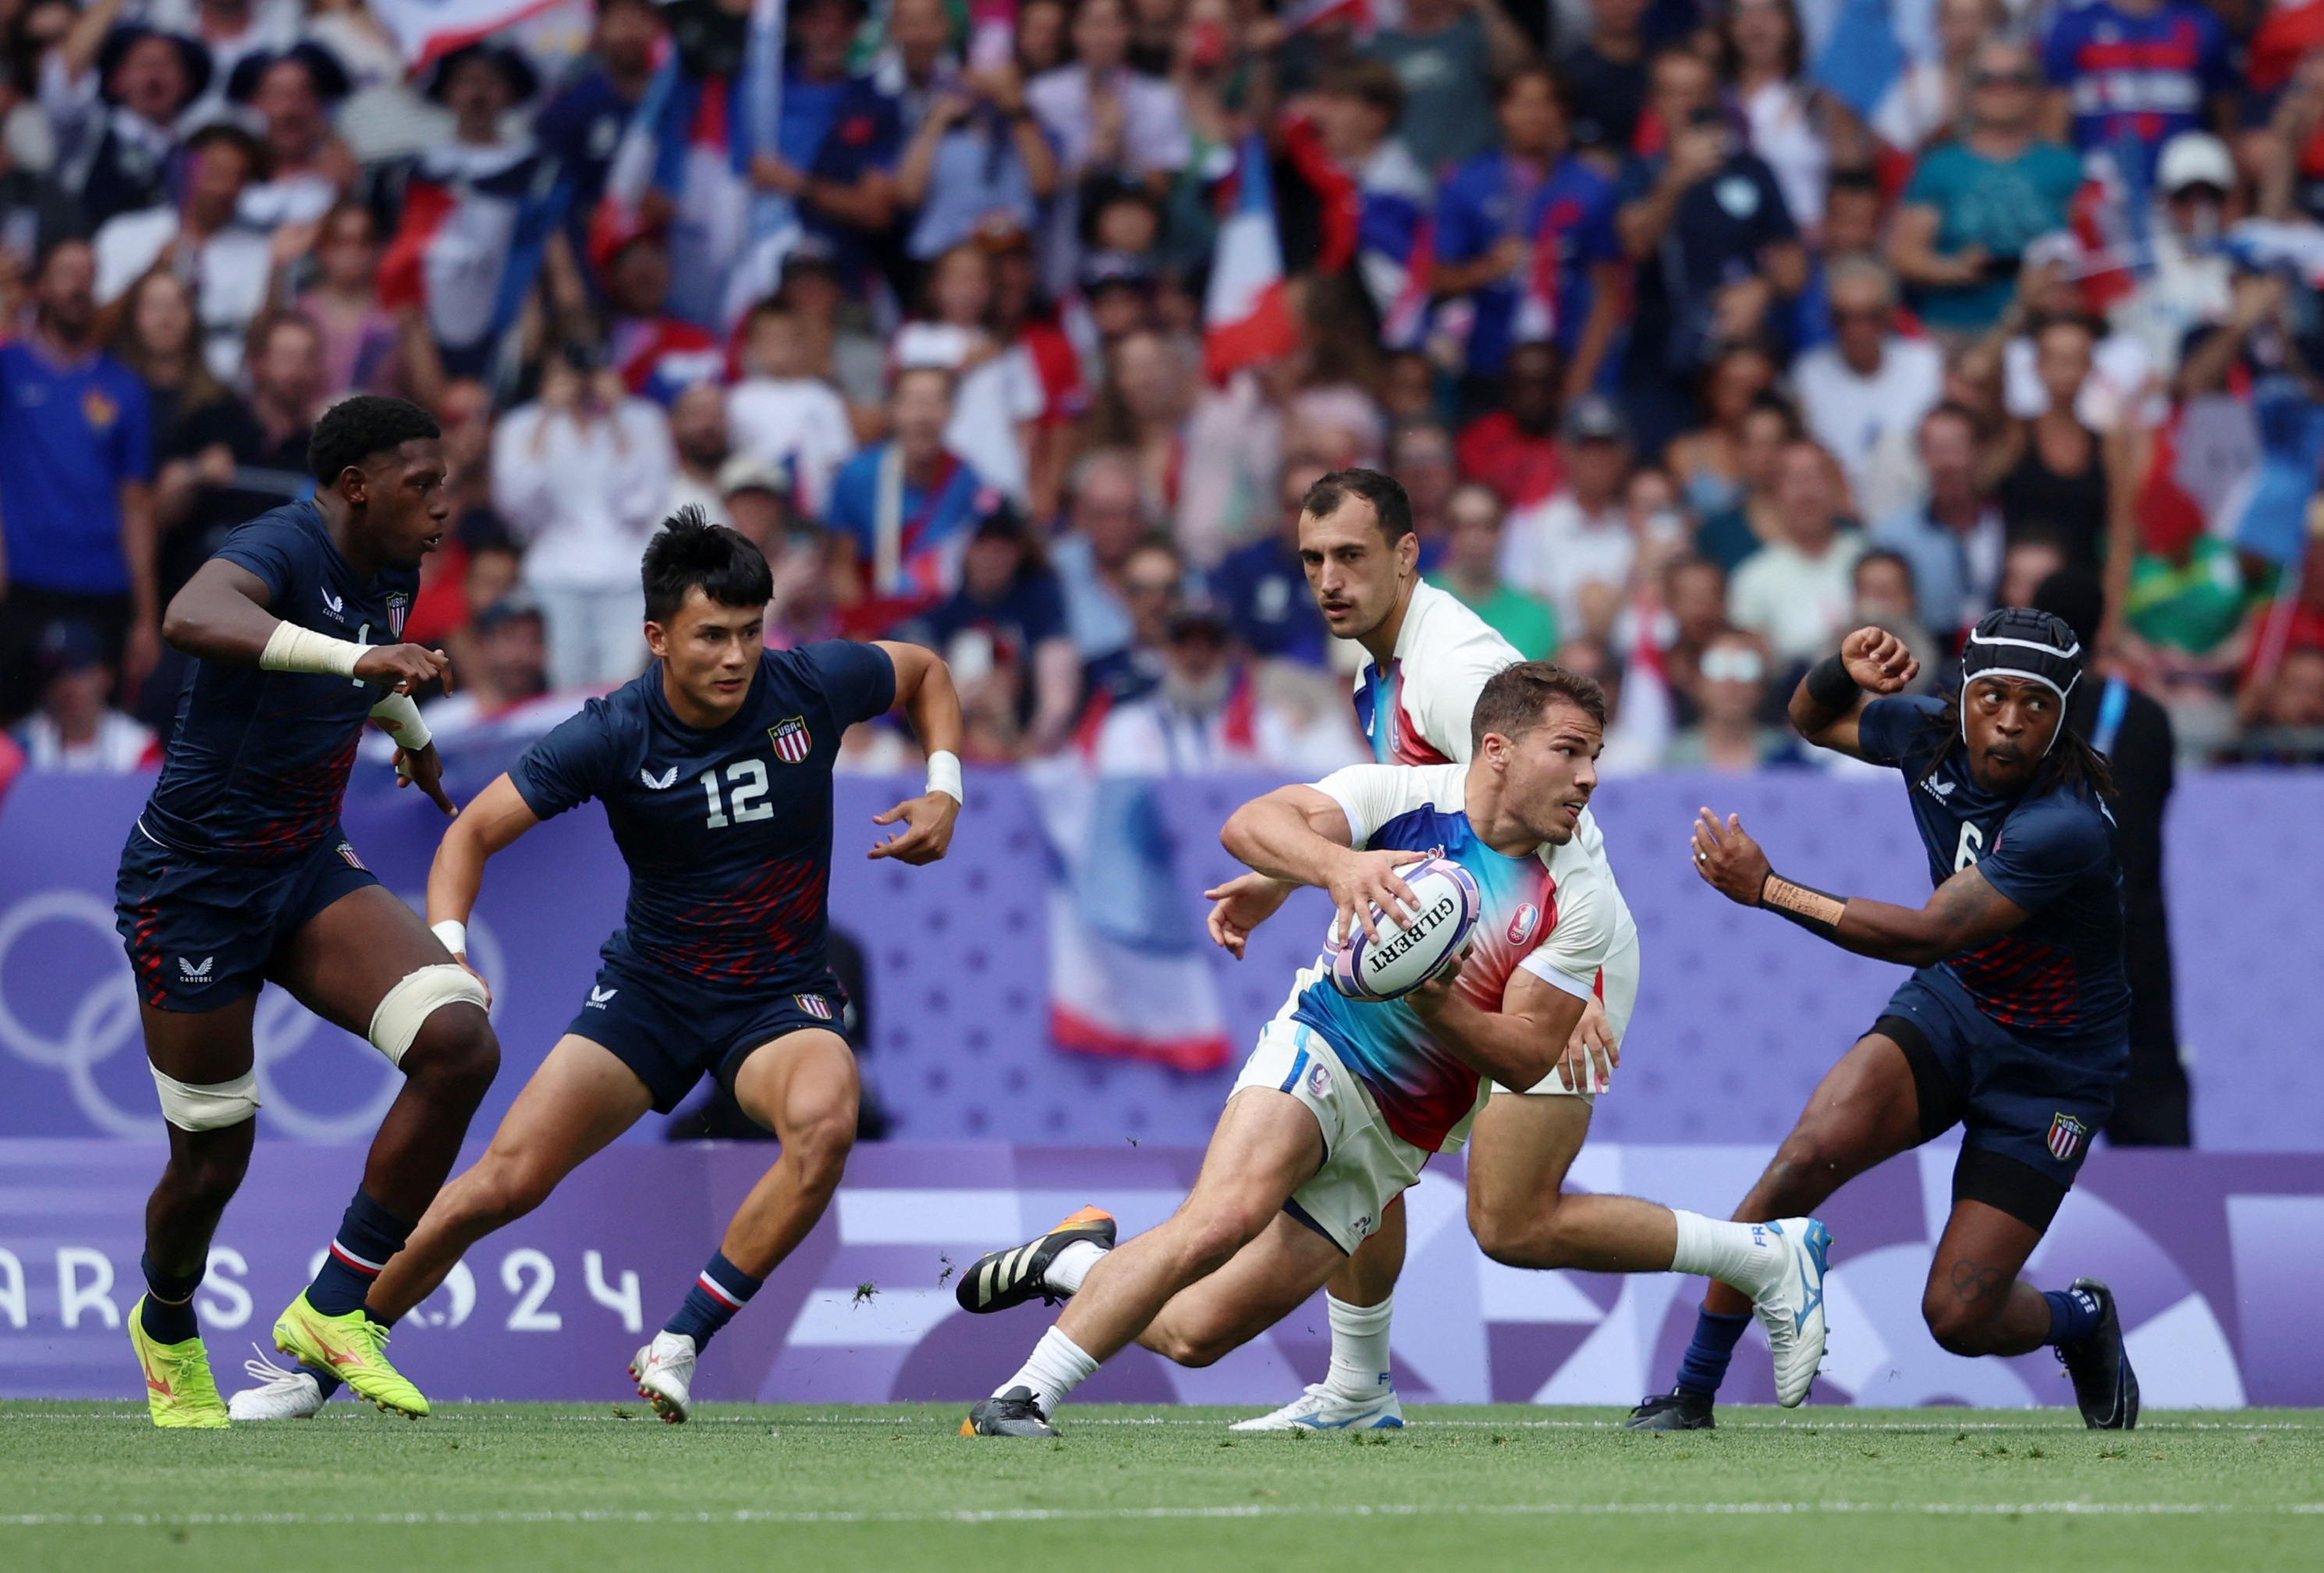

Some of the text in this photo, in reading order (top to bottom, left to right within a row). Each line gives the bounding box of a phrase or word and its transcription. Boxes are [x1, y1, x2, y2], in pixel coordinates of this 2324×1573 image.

[777, 722, 797, 737] USA
[700, 758, 775, 829] 12
[1369, 897, 1454, 974] GILBERT
[2062, 1118, 2079, 1134] USA
[0, 1246, 644, 1333] ARS 024
